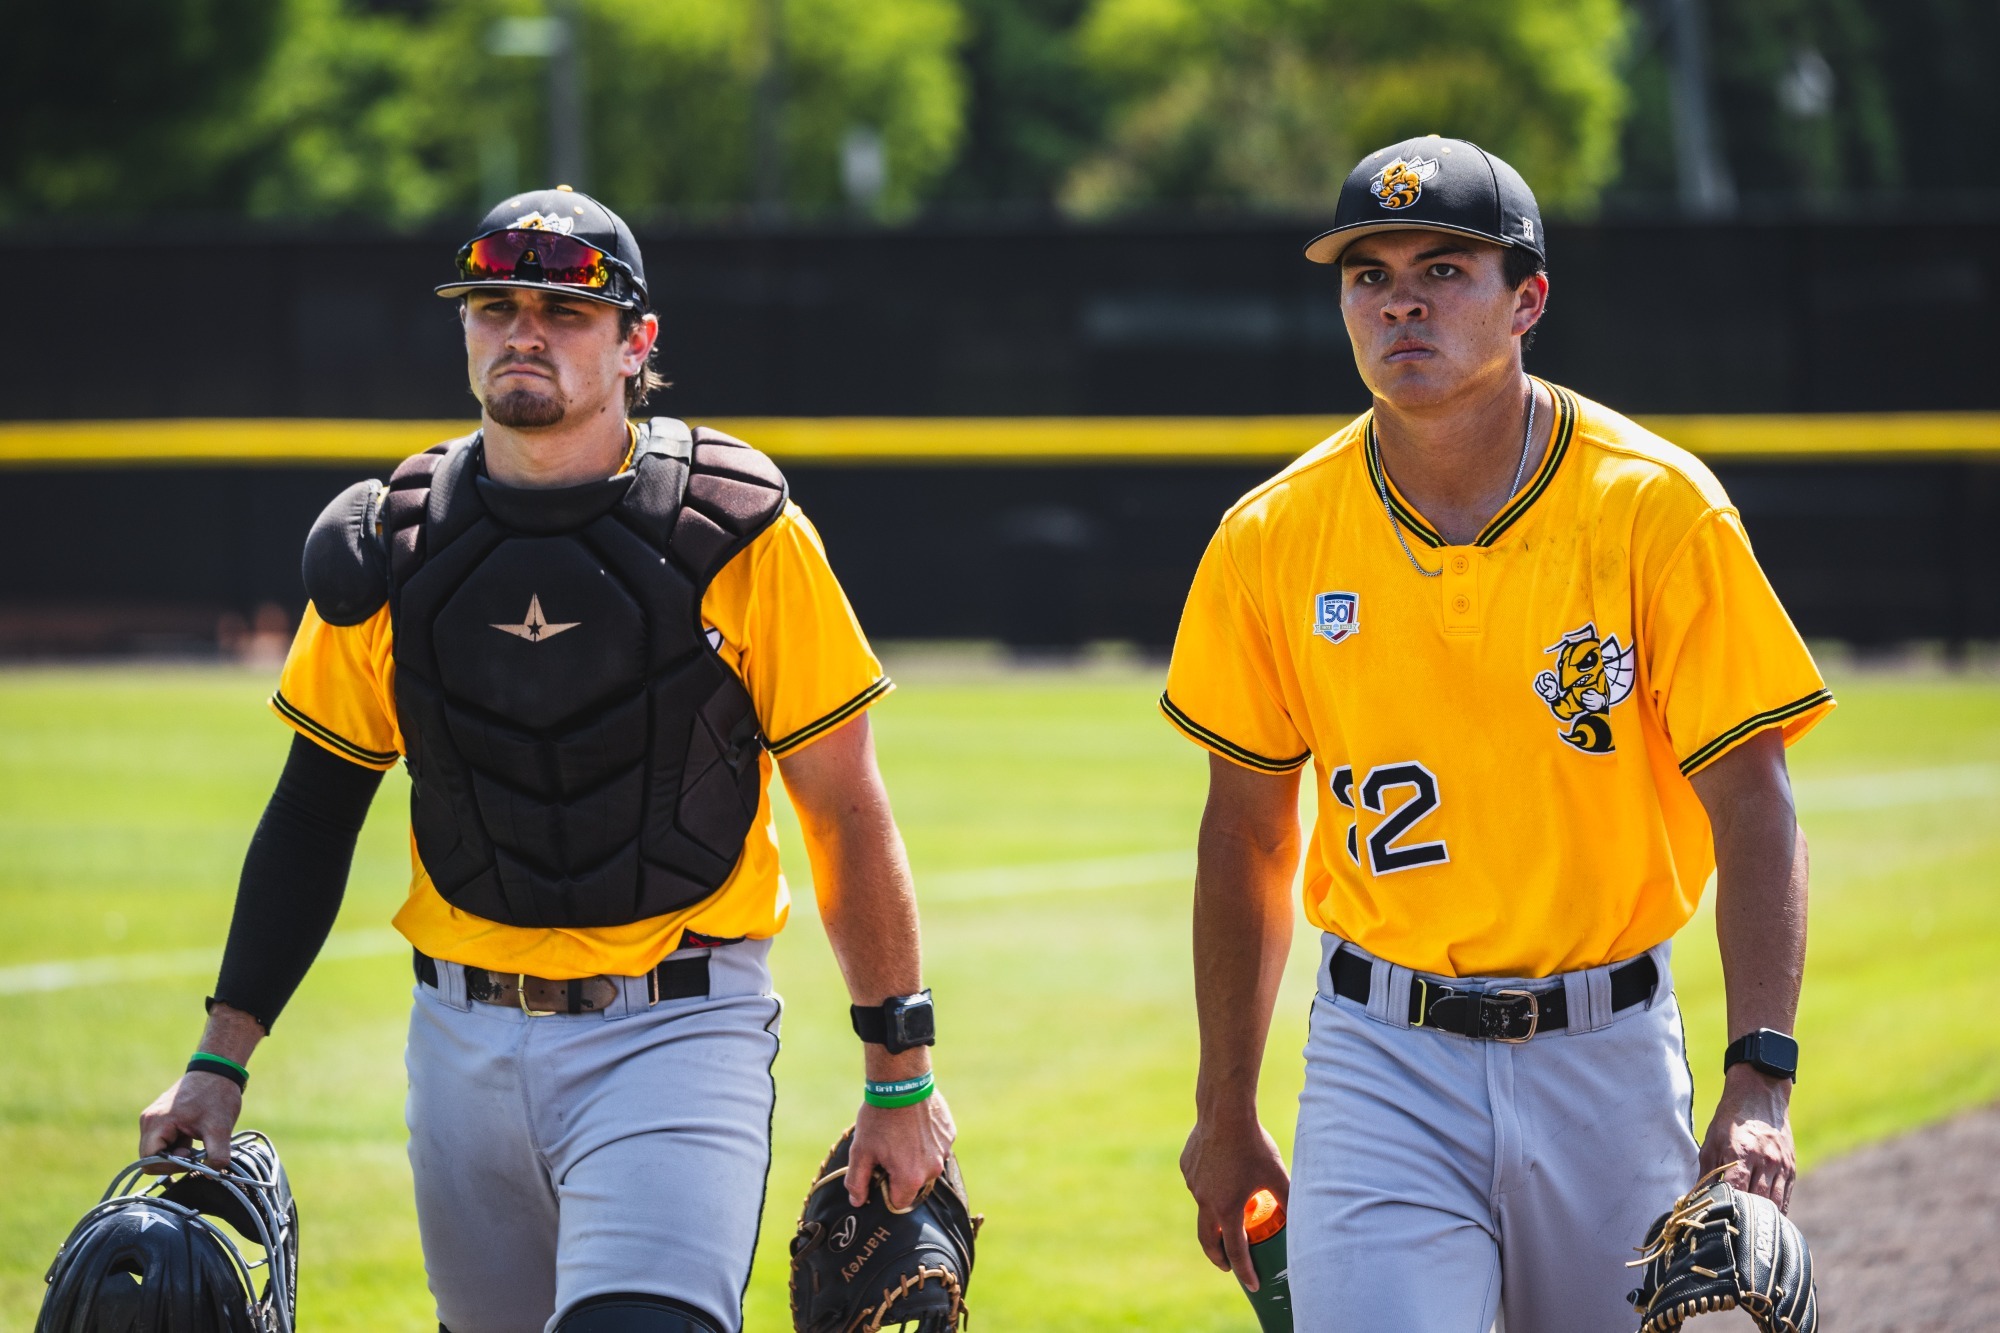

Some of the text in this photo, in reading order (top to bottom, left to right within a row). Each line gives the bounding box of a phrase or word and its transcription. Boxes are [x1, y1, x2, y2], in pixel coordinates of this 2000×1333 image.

[1325, 604, 1349, 623] 50
[875, 1085, 893, 1093] Grit
[840, 1226, 892, 1283] Harvey
